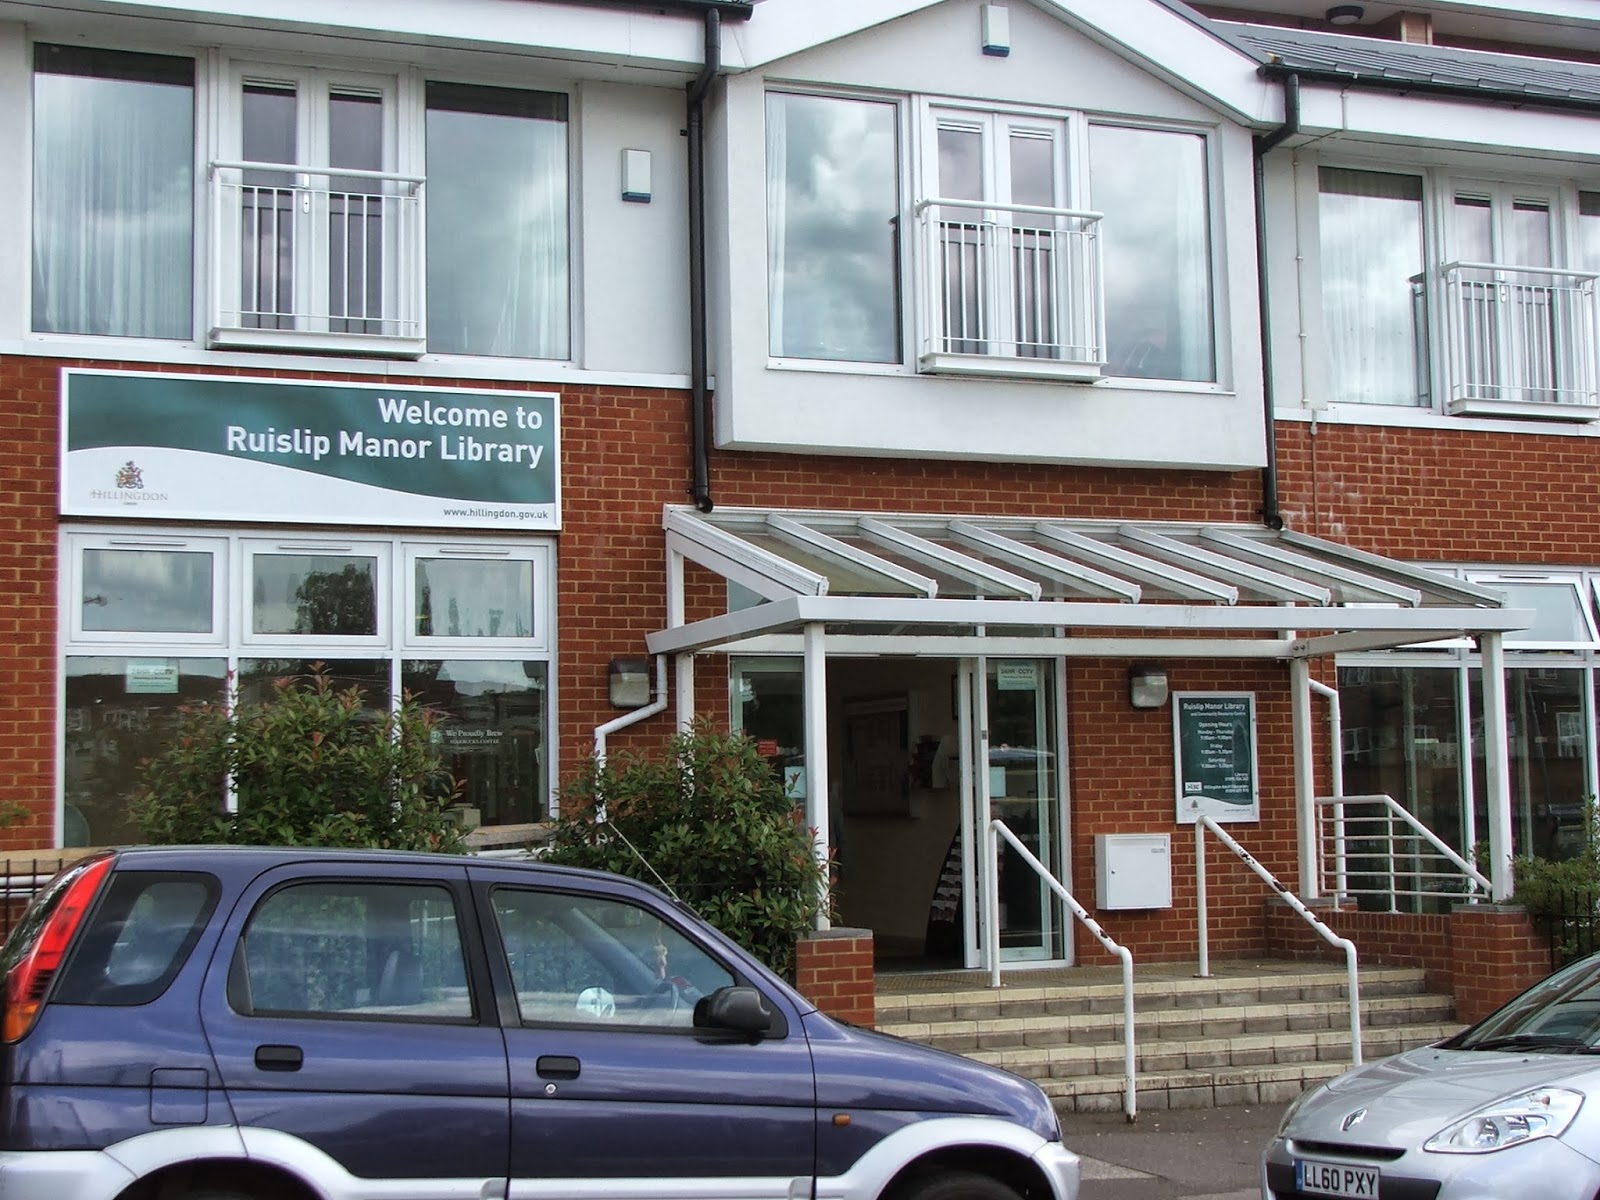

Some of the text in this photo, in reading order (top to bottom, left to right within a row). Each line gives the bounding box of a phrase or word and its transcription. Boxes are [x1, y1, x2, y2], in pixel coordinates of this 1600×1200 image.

[378, 398, 543, 430] Welcome to
[227, 425, 544, 469] Ruislip Manor Library
[90, 489, 168, 501] HILLINGDON
[443, 508, 548, 520] www.hillingdon.gov.uk
[1183, 702, 1204, 711] Ruislip
[1224, 702, 1246, 711] Library
[458, 729, 485, 738] Proudly
[486, 729, 503, 737] Brew
[1304, 1165, 1376, 1195] LL60 PXY
